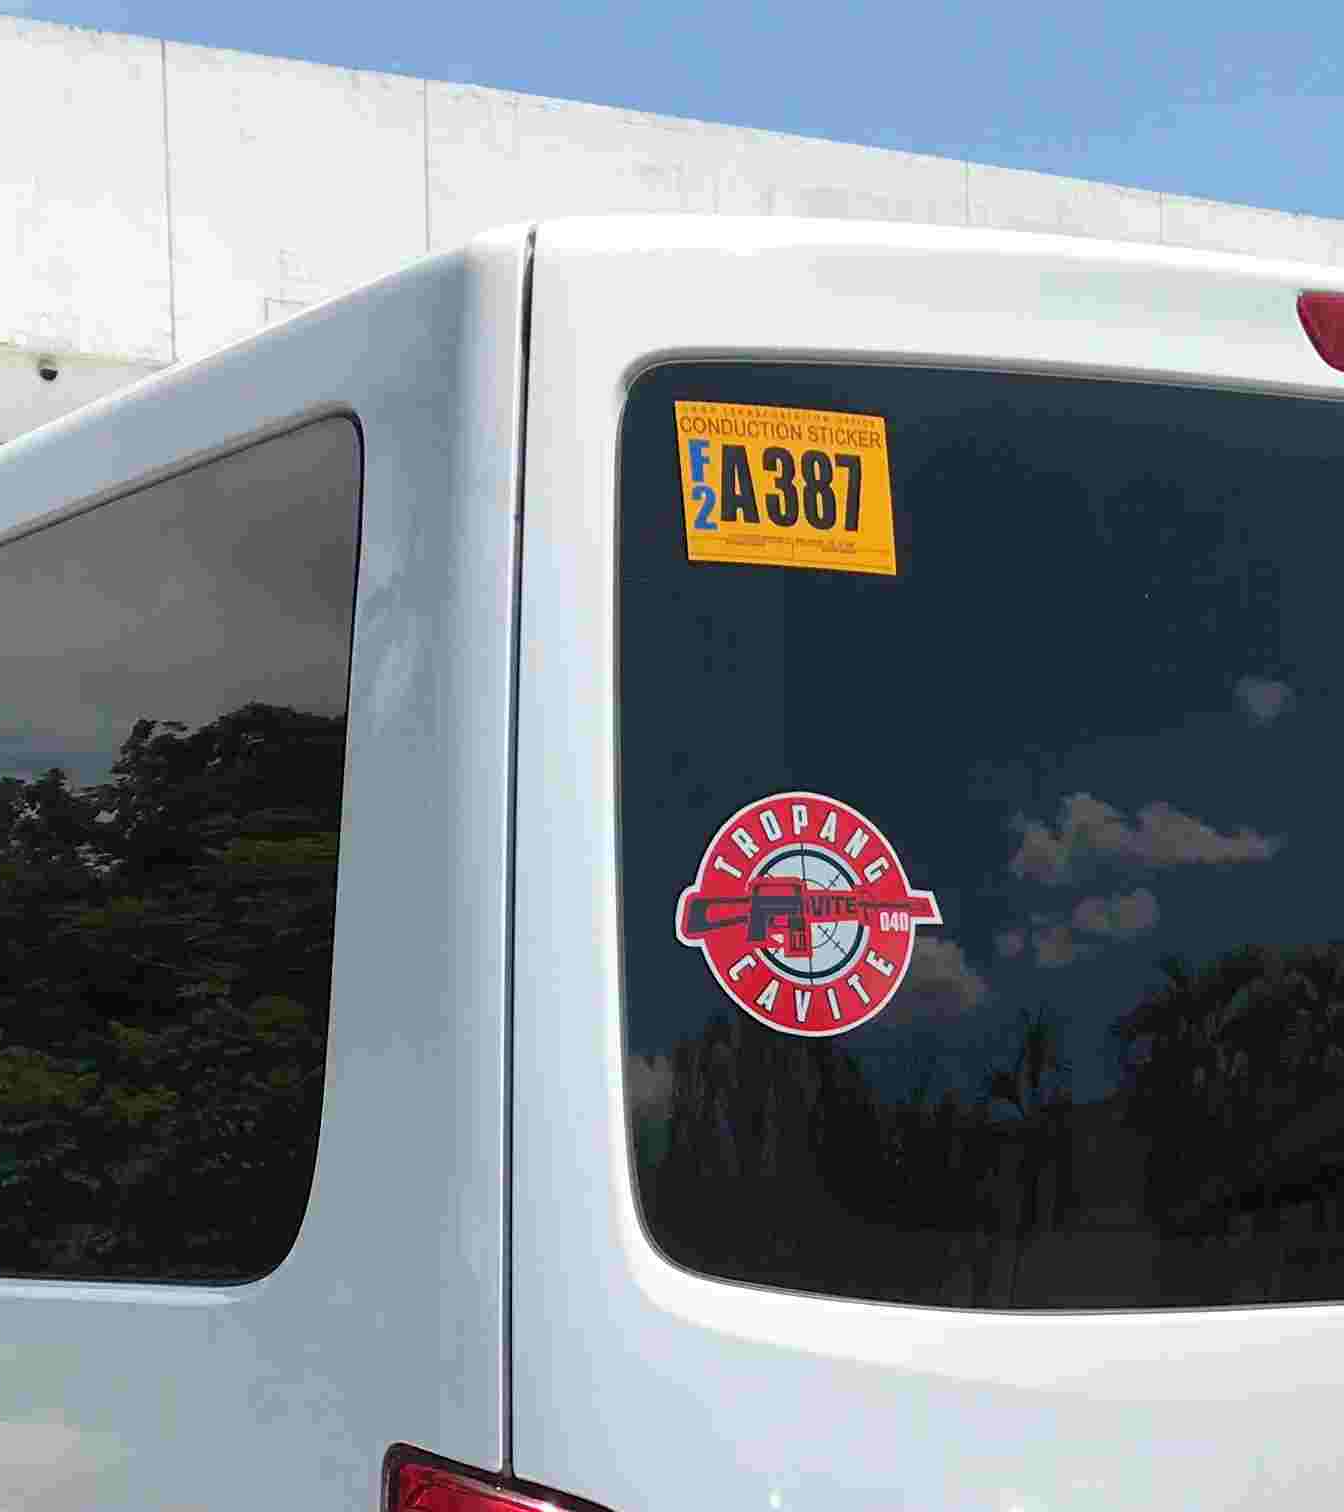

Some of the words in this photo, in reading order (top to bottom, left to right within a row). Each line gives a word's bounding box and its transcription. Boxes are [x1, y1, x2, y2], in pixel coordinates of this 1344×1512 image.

[678, 415, 803, 442] CONDUCTION
[806, 423, 882, 450] STICKER
[720, 443, 862, 534] A387
[713, 803, 890, 883] TROPANG
[728, 949, 896, 1023] CAVITE
